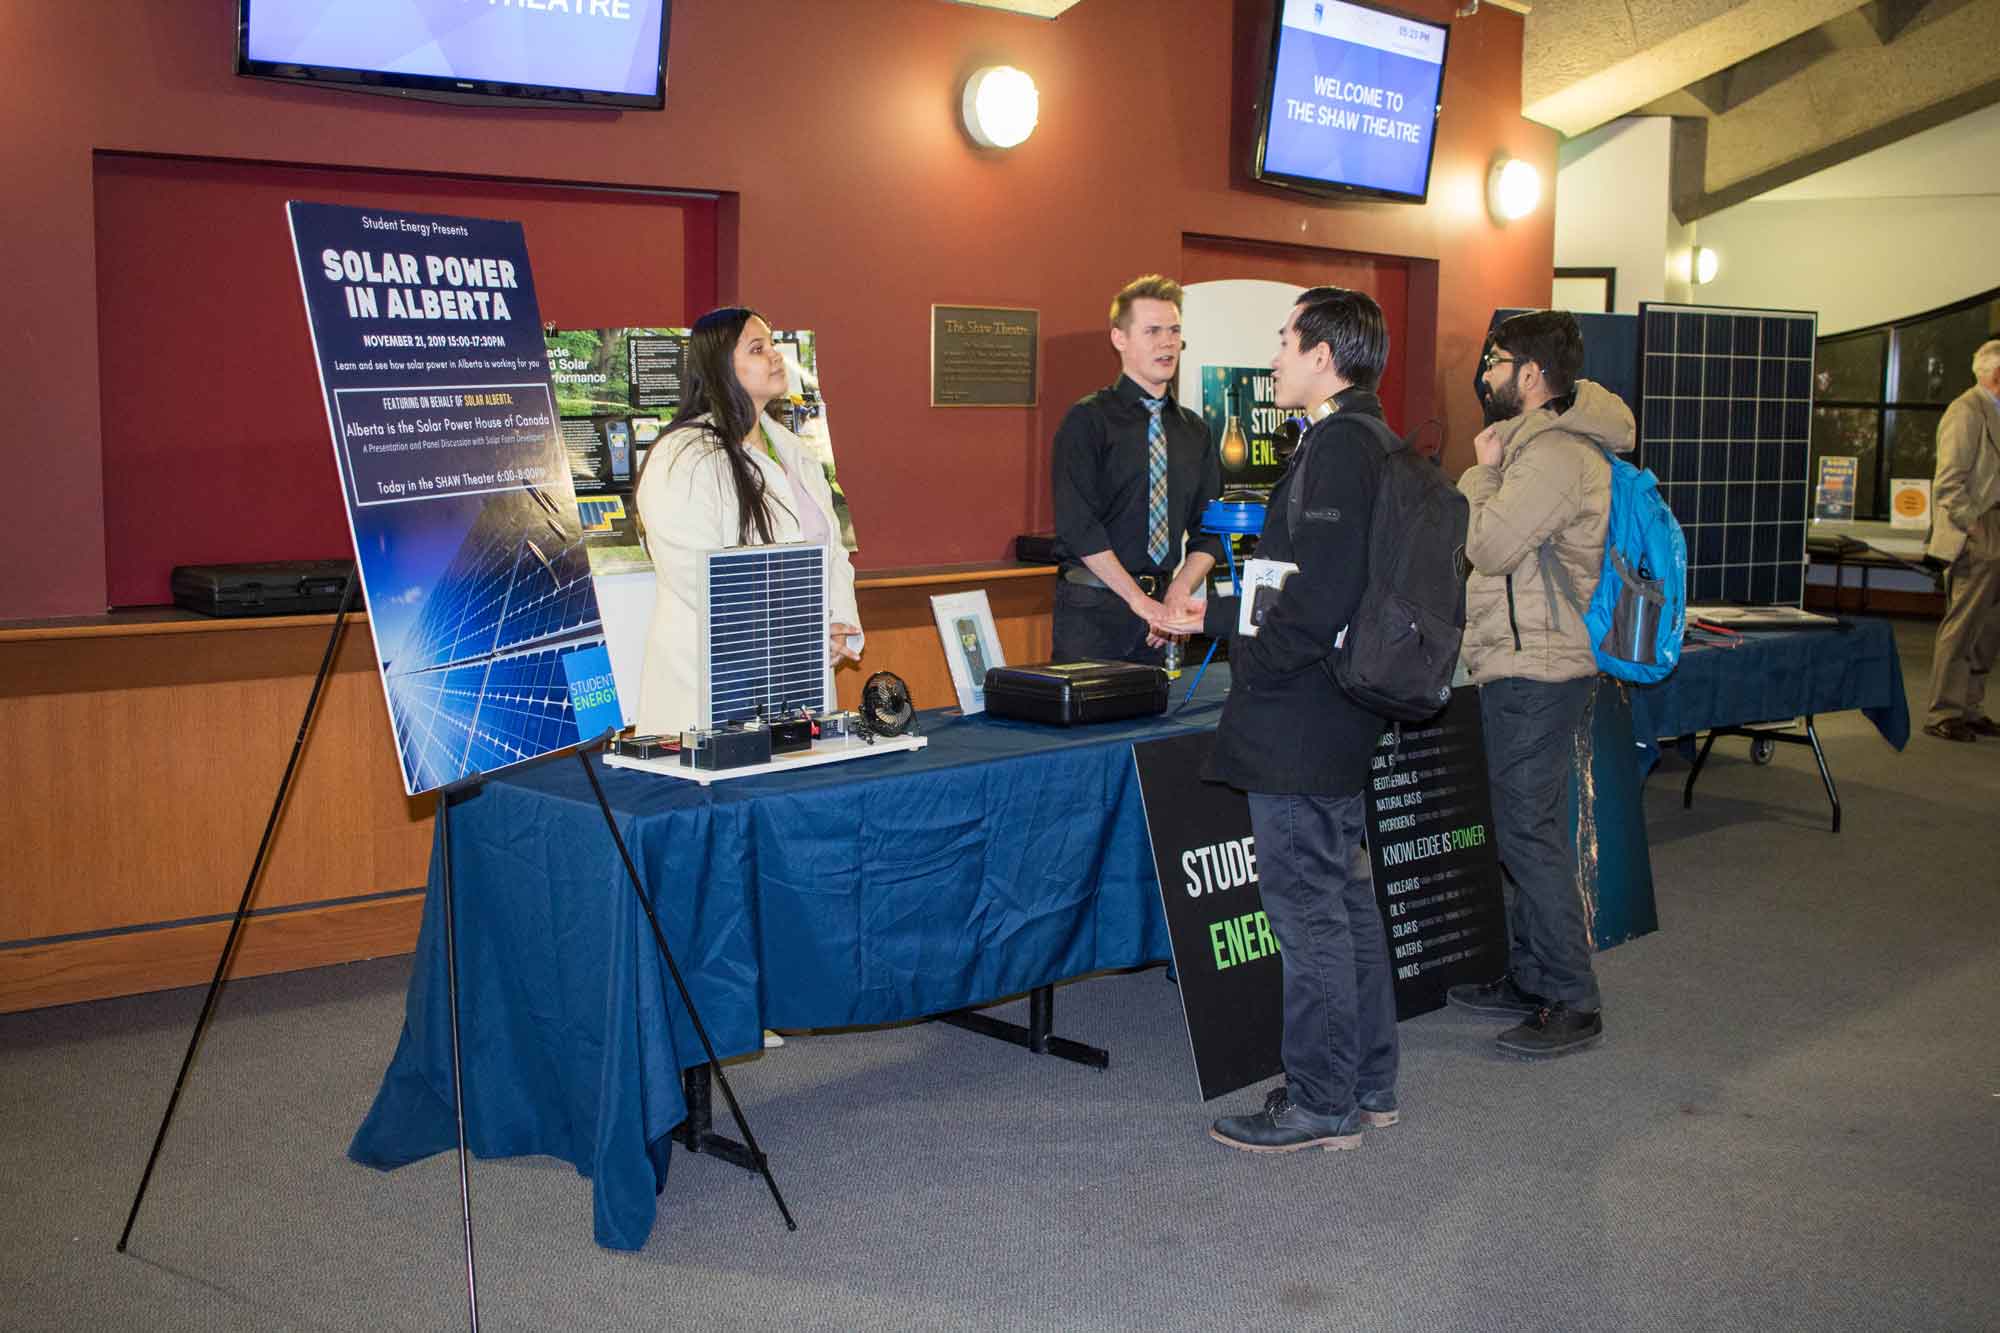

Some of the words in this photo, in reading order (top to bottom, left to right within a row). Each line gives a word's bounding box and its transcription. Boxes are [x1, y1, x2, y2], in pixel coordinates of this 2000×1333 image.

[488, 0, 631, 20] ATRE
[1314, 75, 1382, 109] WELCOME
[1386, 91, 1404, 112] TO
[1286, 99, 1315, 123] THE
[1317, 105, 1360, 132] SHAW
[1362, 114, 1421, 144] THEATRE
[362, 216, 398, 231] Student
[400, 221, 431, 237] Energy
[432, 223, 469, 236] Presents
[322, 249, 422, 285] SOLAR
[425, 255, 518, 288] POWER
[345, 286, 379, 318] IN
[387, 288, 512, 320] ALBERTA
[363, 335, 414, 348] NOVEMBER
[428, 336, 446, 348] 2019
[448, 336, 506, 347] 15:00-17:30PM
[335, 361, 358, 370] Learn
[359, 360, 374, 370] and
[375, 362, 388, 370] see
[390, 361, 404, 370] how
[407, 360, 424, 370] solar
[426, 362, 448, 372] power
[450, 360, 457, 369] in
[458, 360, 483, 369] Alberta
[484, 360, 490, 368] is
[491, 359, 516, 371] working
[517, 357, 527, 368] for
[528, 361, 540, 370] you
[559, 359, 589, 370] Solar
[629, 340, 639, 385] Background
[551, 373, 607, 384] rformance
[1252, 376, 1275, 402] WH
[383, 397, 419, 410] FEATURING
[420, 397, 429, 408] ON
[430, 395, 454, 408] BEHALF
[455, 395, 463, 406] OF
[464, 394, 485, 406] SOLAR
[347, 422, 384, 437] Alberta
[387, 422, 395, 434] is
[398, 420, 414, 433] the
[416, 418, 442, 433] Solar
[445, 417, 473, 431] Power
[475, 416, 502, 429] House
[504, 414, 513, 427] of
[516, 412, 550, 426] Canada
[1252, 407, 1306, 434] STUD
[369, 442, 408, 453] Presentation
[410, 441, 422, 451] and
[423, 440, 440, 449] Panel
[441, 438, 471, 448] Discussion
[1252, 440, 1278, 466] ENE
[377, 481, 406, 495] Today
[408, 479, 417, 491] in
[419, 477, 434, 490] the
[435, 475, 461, 489] SHAW
[462, 472, 495, 486] Theater
[570, 673, 615, 696] STUDENT
[574, 687, 617, 711] ENERGY
[1373, 772, 1411, 791] GEOTHERMAL
[1376, 795, 1404, 812] NATURAL
[1404, 792, 1416, 806] GAS
[1378, 815, 1410, 833] HYDROGEN
[1410, 813, 1416, 827] IS
[1382, 834, 1442, 867] KNOWLEDGE
[1442, 831, 1452, 853] IS
[1452, 825, 1486, 850] POWER
[1182, 836, 1259, 898] STUDE
[1387, 879, 1414, 896] NUCLEAR
[1414, 876, 1421, 890] IS
[1390, 904, 1401, 917] OIL
[1401, 902, 1407, 914] IS
[1392, 922, 1412, 938] SOLAR
[1412, 919, 1419, 933] IS
[1209, 911, 1281, 971] ENER
[1395, 941, 1416, 960] WATER
[1416, 939, 1424, 953] IS
[1397, 964, 1414, 980] WIND
[1413, 962, 1420, 976] IS
